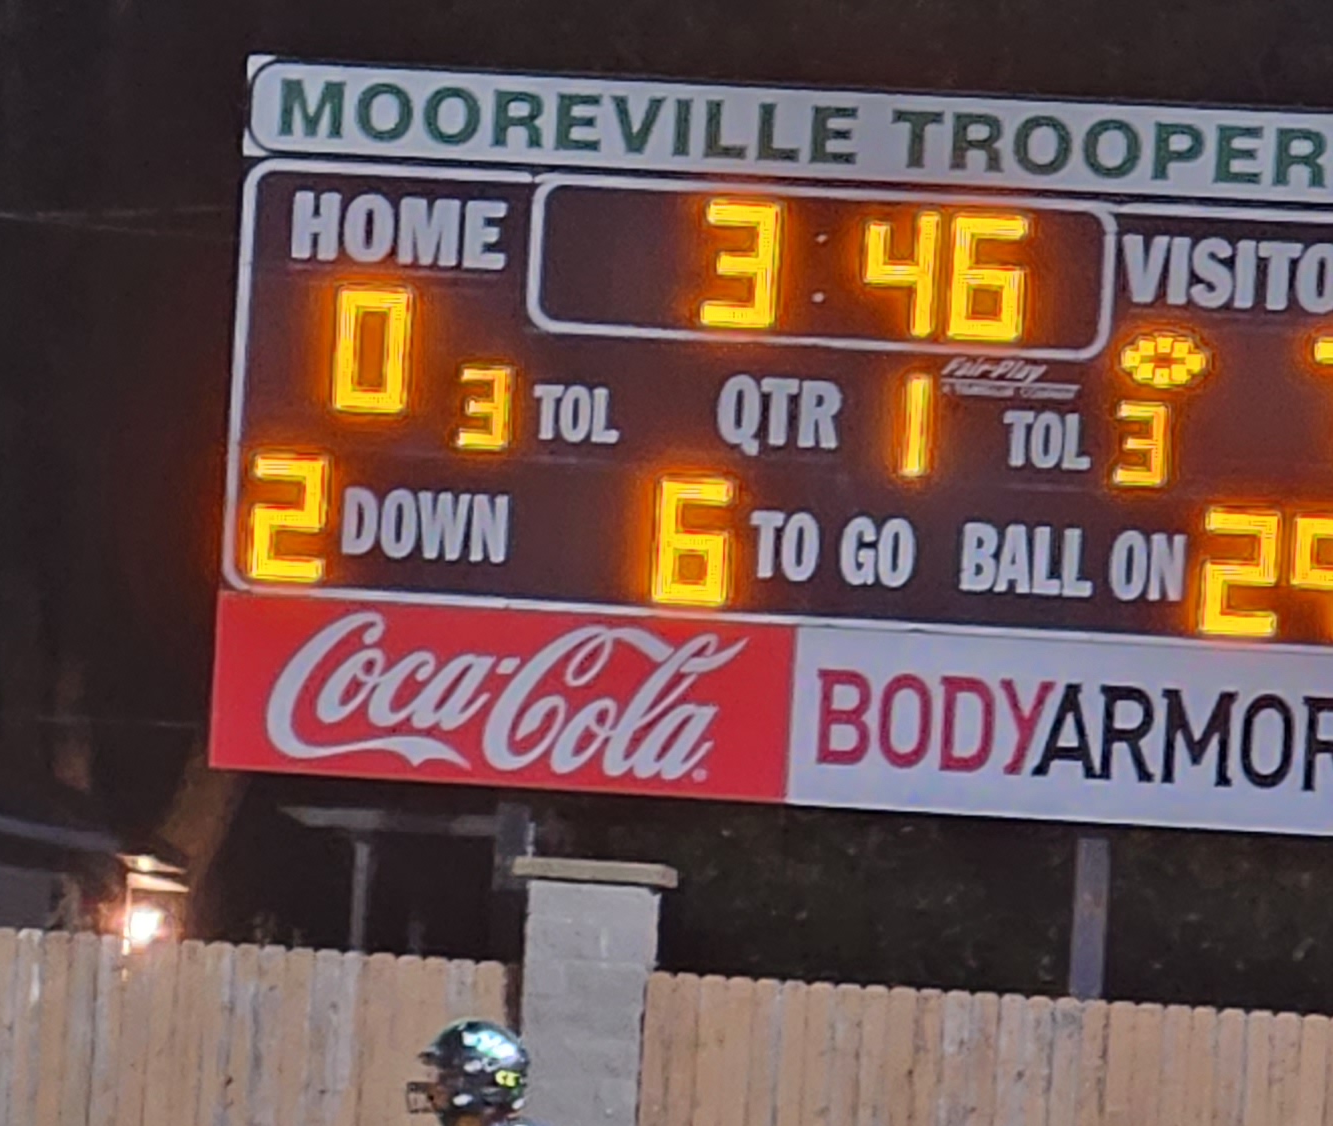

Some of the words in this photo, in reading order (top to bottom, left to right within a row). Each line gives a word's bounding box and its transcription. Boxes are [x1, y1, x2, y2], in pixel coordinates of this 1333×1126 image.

[277, 77, 860, 165] MOOREVILLE
[892, 108, 1328, 189] TROOPER
[290, 190, 508, 271] HOME
[1121, 232, 1333, 314] VISITO
[333, 285, 411, 415] 0
[455, 364, 515, 451] 3
[533, 384, 620, 445] TOL
[716, 373, 843, 457] QTR
[899, 374, 930, 478] 1
[1003, 410, 1091, 470] TOL
[1111, 401, 1169, 487] 3
[246, 453, 329, 584] 2
[341, 486, 510, 564] DOWN
[651, 476, 735, 608] 6
[749, 509, 820, 582] TO
[839, 516, 917, 589] GO
[959, 521, 1093, 599] BALL
[1108, 529, 1188, 602] ON
[265, 611, 750, 782] Coca-Cola
